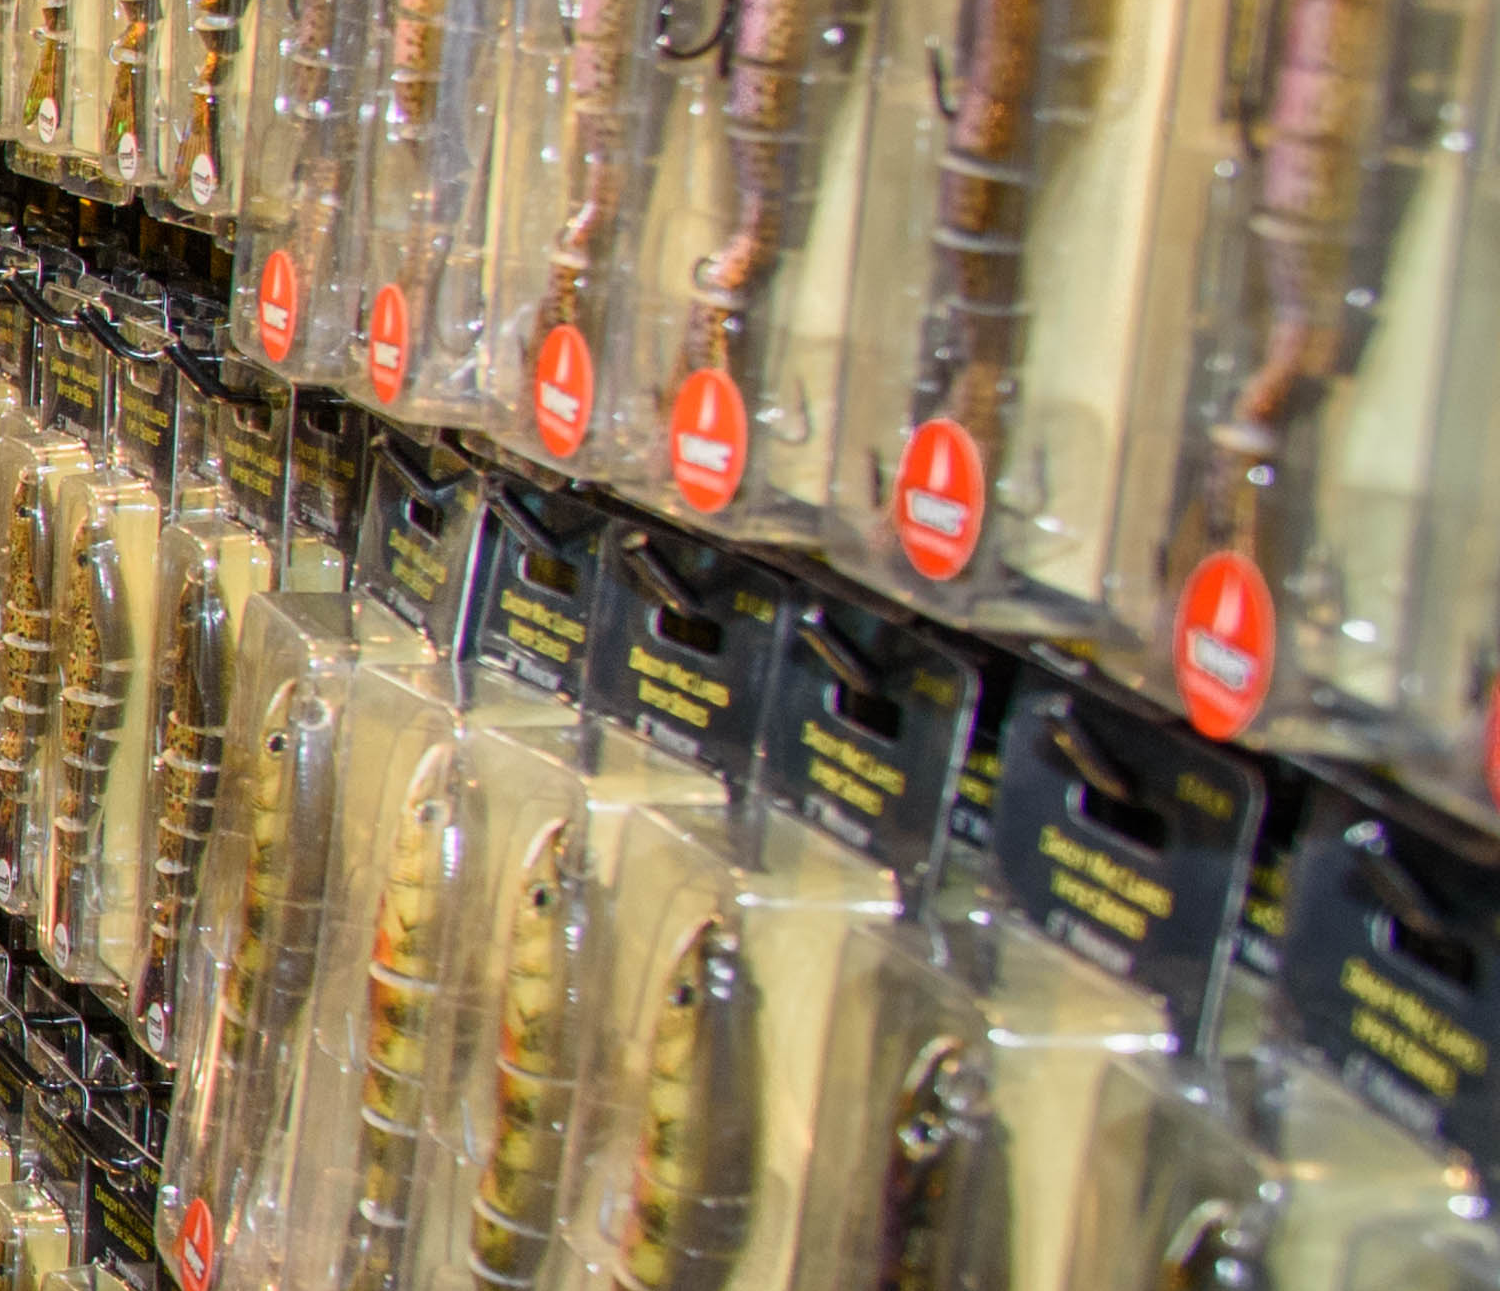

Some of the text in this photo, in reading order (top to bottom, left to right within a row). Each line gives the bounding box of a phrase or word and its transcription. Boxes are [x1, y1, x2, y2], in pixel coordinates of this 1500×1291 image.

[371, 337, 403, 372] VMC
[539, 381, 580, 424] VMC
[679, 432, 731, 473] VMC
